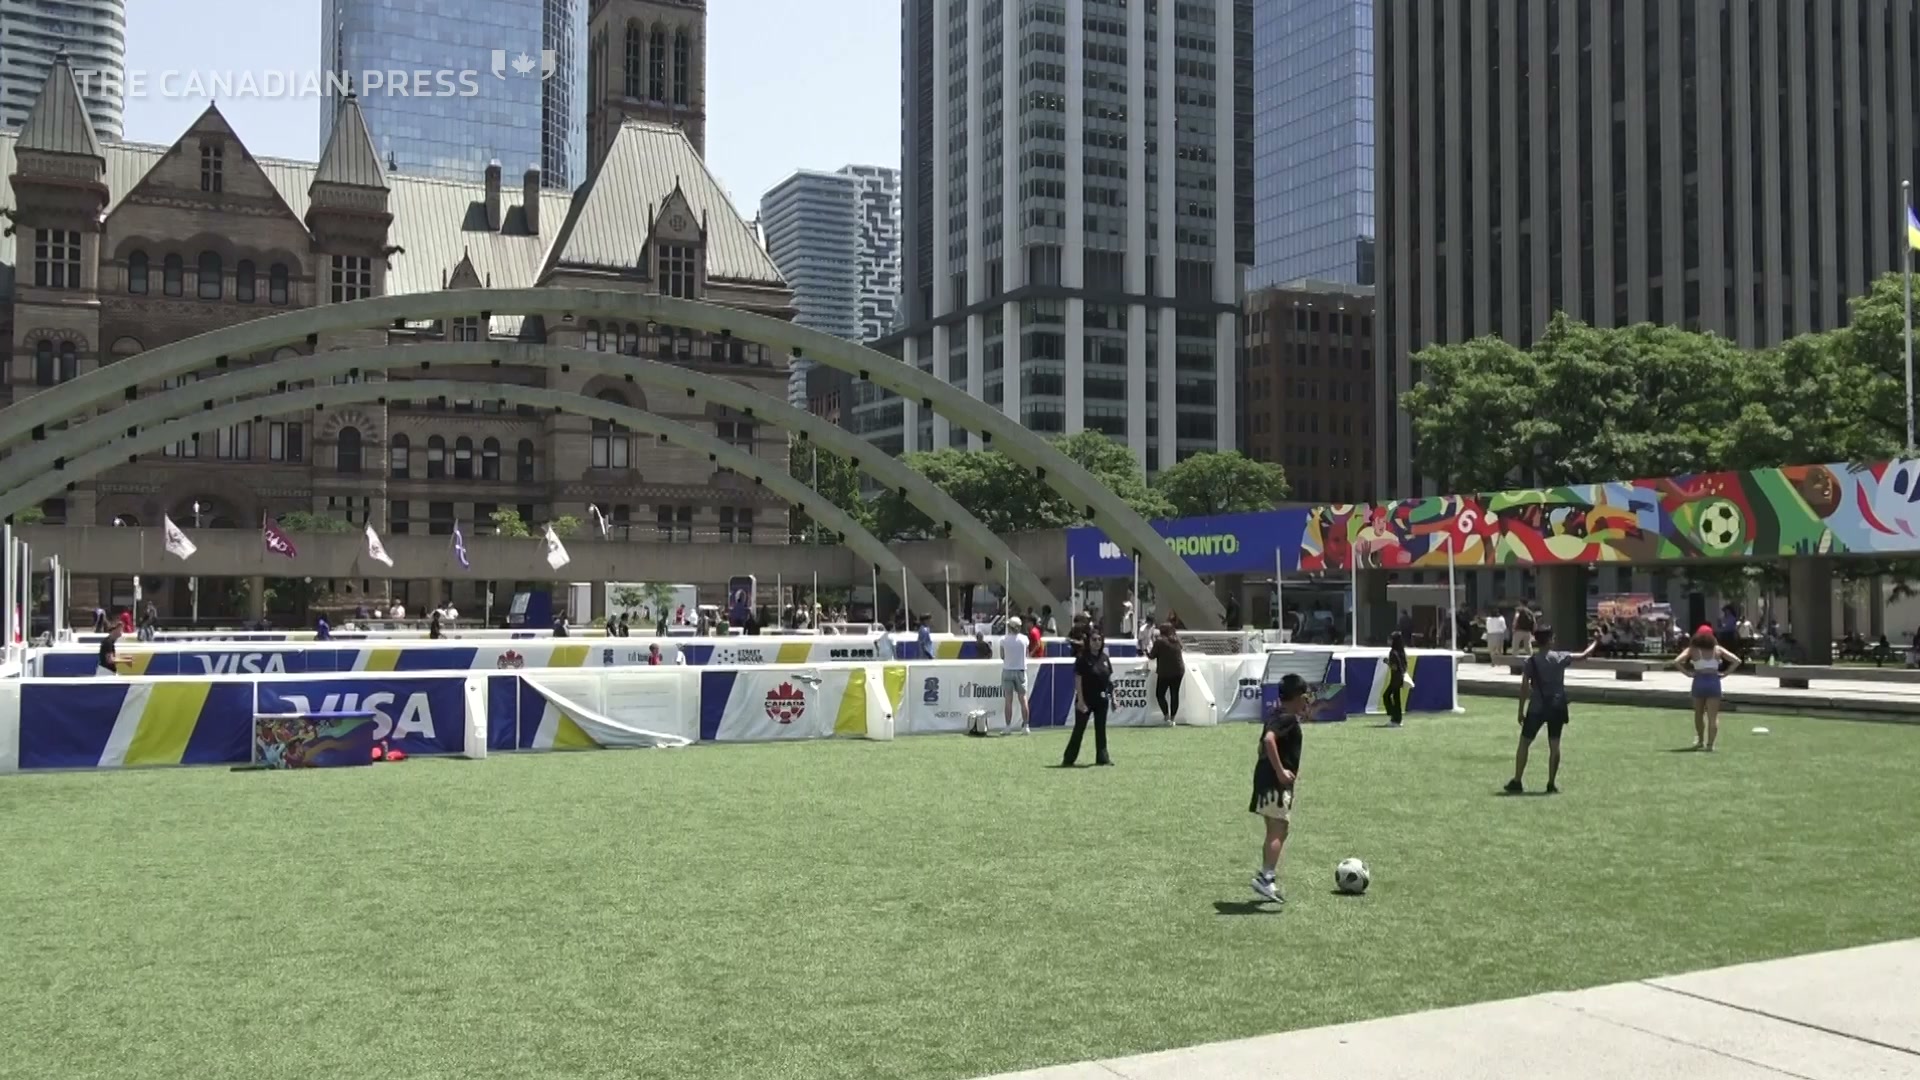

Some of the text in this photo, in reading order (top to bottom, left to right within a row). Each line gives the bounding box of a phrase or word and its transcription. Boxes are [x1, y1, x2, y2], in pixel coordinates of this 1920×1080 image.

[1458, 509, 1478, 534] 6
[1165, 534, 1236, 556] ORONTO
[192, 652, 286, 675] VISA
[972, 683, 1005, 698] TORONT
[1113, 679, 1146, 688] STREET
[764, 700, 806, 708] CANADA
[1115, 699, 1147, 708] ANAD
